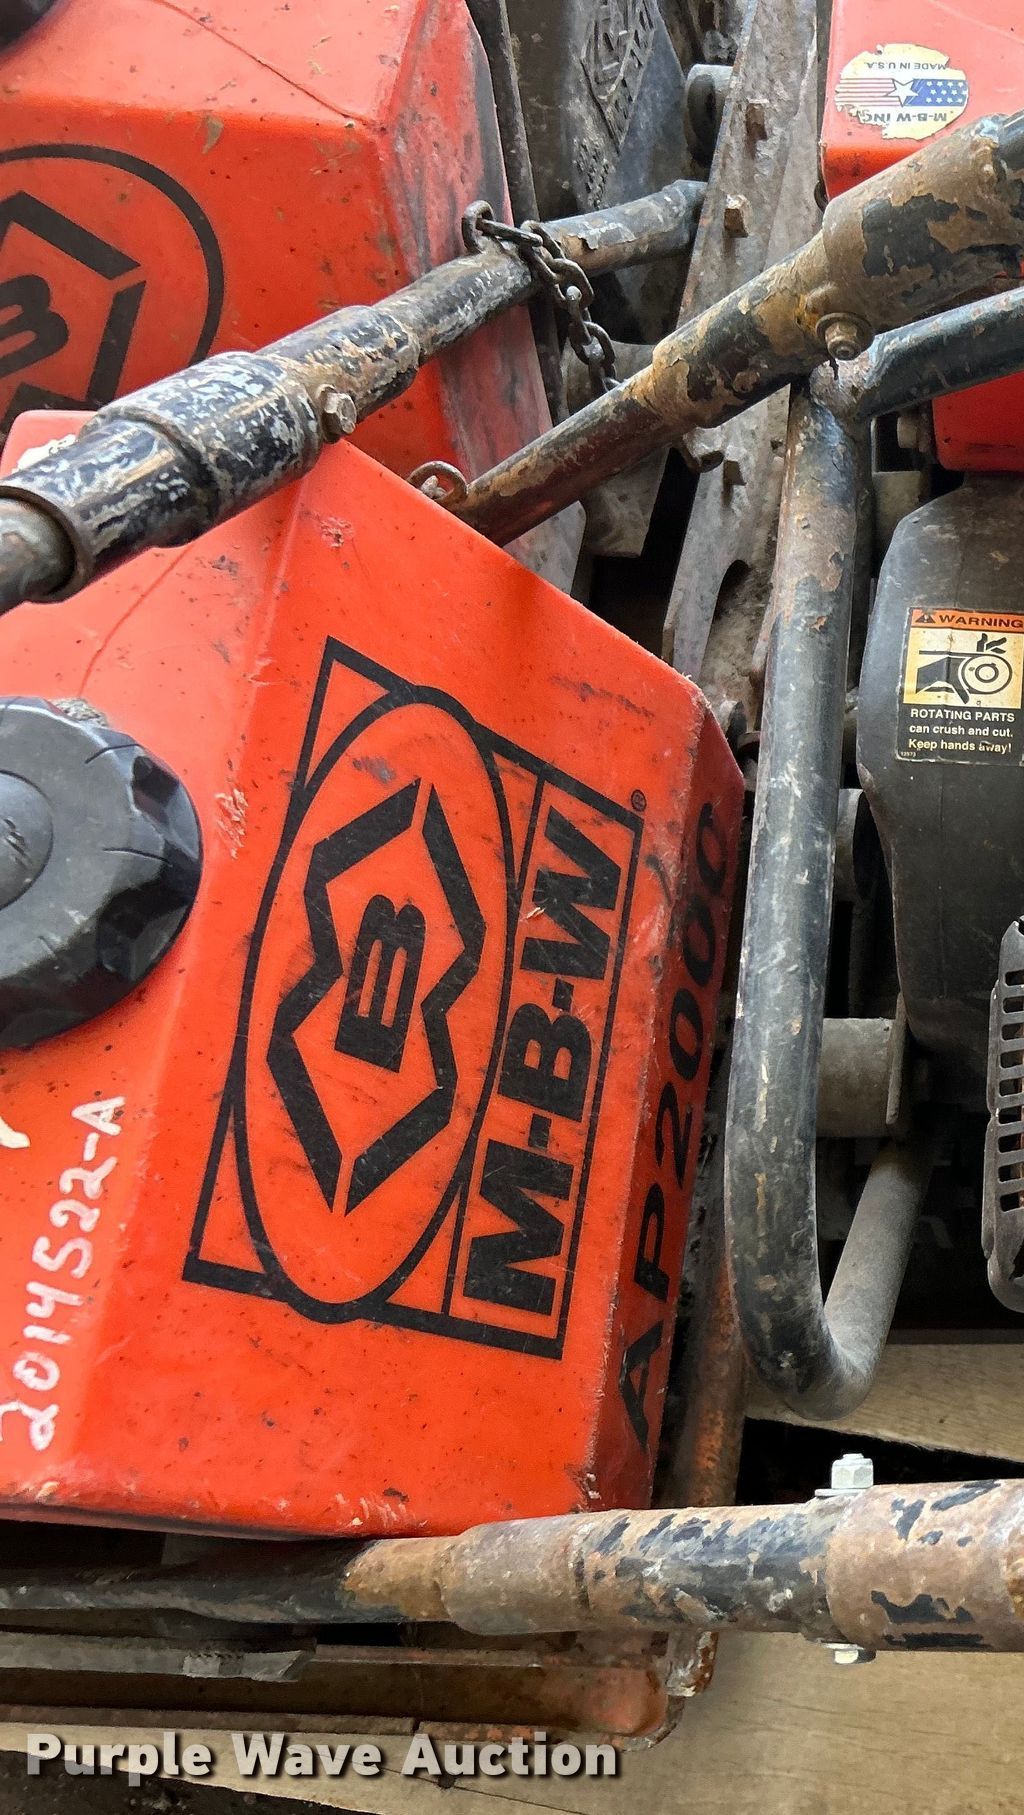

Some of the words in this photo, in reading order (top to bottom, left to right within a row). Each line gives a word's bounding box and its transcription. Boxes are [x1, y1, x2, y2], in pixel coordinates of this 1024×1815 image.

[914, 62, 946, 70] MADE
[897, 113, 947, 122] M-B-W
[939, 614, 1024, 628] WARNING
[910, 708, 972, 720] ROTATING
[975, 712, 1015, 722] PARTS
[909, 724, 930, 734] can
[932, 724, 965, 735] crush
[968, 725, 990, 736] and
[992, 727, 1013, 737] cut.
[909, 739, 938, 750] Keep
[940, 739, 976, 751] hands
[979, 743, 1012, 754] away!
[462, 813, 624, 1317] M-B-W
[617, 802, 726, 1448] AP2000
